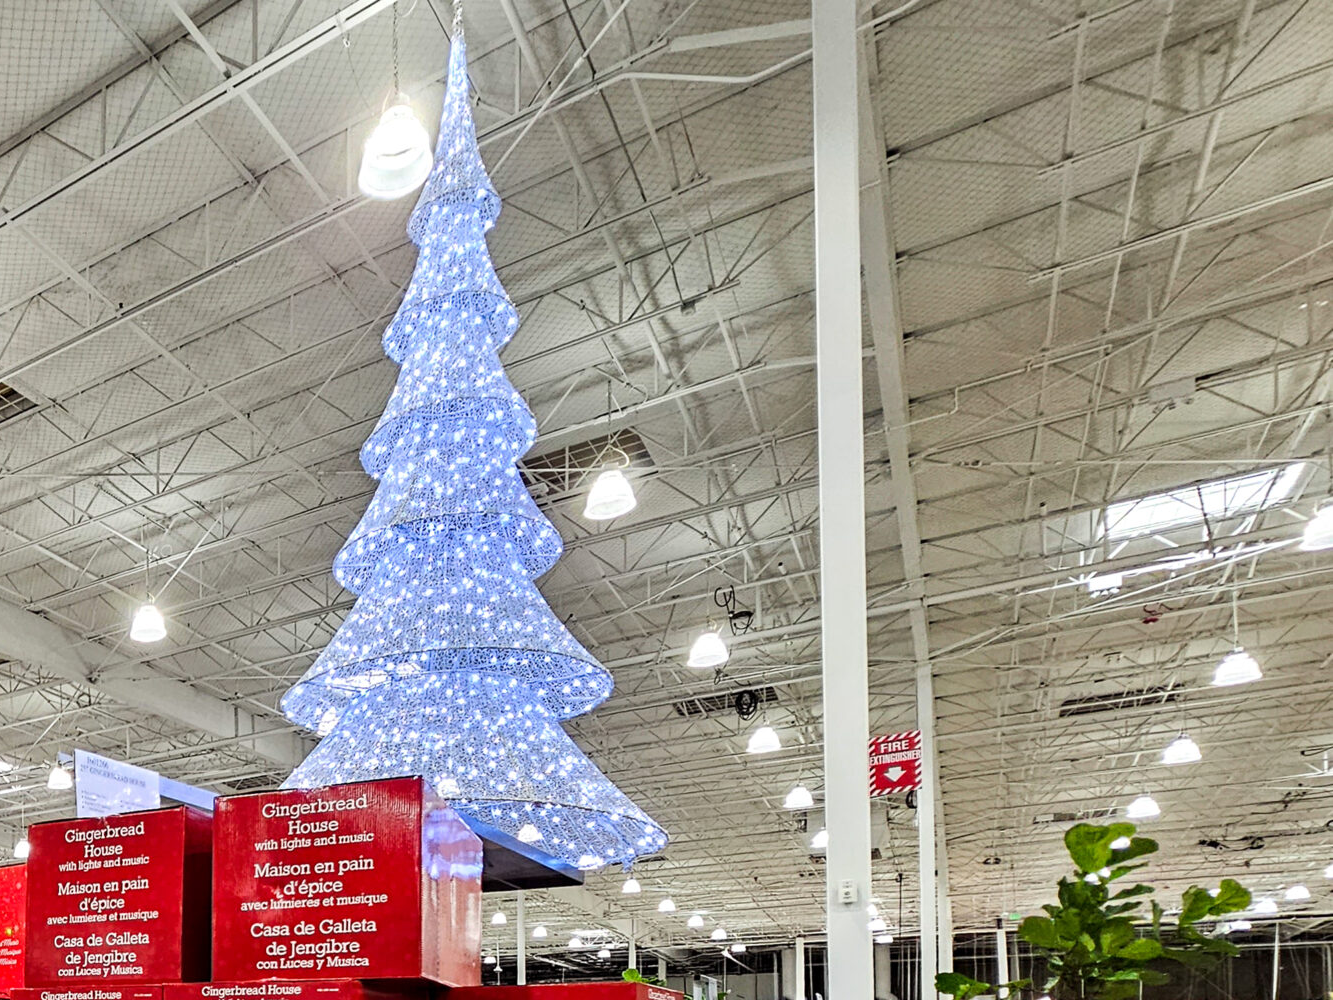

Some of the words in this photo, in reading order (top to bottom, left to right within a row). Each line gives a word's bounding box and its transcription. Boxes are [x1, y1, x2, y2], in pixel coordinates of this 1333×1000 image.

[880, 740, 909, 753] FIRE
[869, 750, 922, 765] EXTINGUISHER
[262, 794, 367, 818] Gingerbread
[65, 822, 145, 844] Gingerbread
[288, 820, 338, 835] House
[255, 841, 278, 851] with
[280, 838, 311, 851] lights
[314, 834, 336, 846] and
[339, 831, 374, 843] music
[84, 844, 123, 858] House
[59, 862, 76, 872] with
[78, 859, 101, 872] lights
[103, 858, 120, 868] and
[122, 854, 149, 866] music
[254, 863, 311, 878] Maison
[314, 863, 334, 873] en
[338, 855, 374, 875] pain
[58, 882, 100, 895] Maison
[103, 882, 119, 892] en
[122, 876, 149, 894] pain
[284, 879, 343, 897] d'épice
[79, 897, 125, 913] d'épice
[241, 901, 268, 911] avec
[322, 896, 334, 906] et
[336, 893, 388, 905] musique
[47, 916, 68, 925] avec
[69, 913, 107, 923] lumieres
[109, 913, 118, 921] et
[119, 910, 159, 921] musique
[250, 924, 290, 937] Casa
[294, 921, 315, 935] de
[319, 919, 377, 934] Galleta
[54, 935, 83, 947] Casa
[86, 934, 102, 945] de
[106, 931, 149, 944] Galleta
[266, 942, 286, 956] de
[289, 939, 360, 958] Jengibre
[66, 952, 81, 964] de
[83, 950, 137, 967] Jengibre
[257, 960, 278, 969] con
[280, 958, 313, 969] Luces
[316, 960, 324, 970] y
[326, 956, 369, 967] Musica
[58, 967, 74, 976] con
[76, 966, 101, 975] Luces
[103, 968, 109, 977] y
[111, 964, 143, 974] Musica
[95, 991, 122, 999] House
[202, 985, 266, 998] Gingerbread
[268, 985, 302, 995] House
